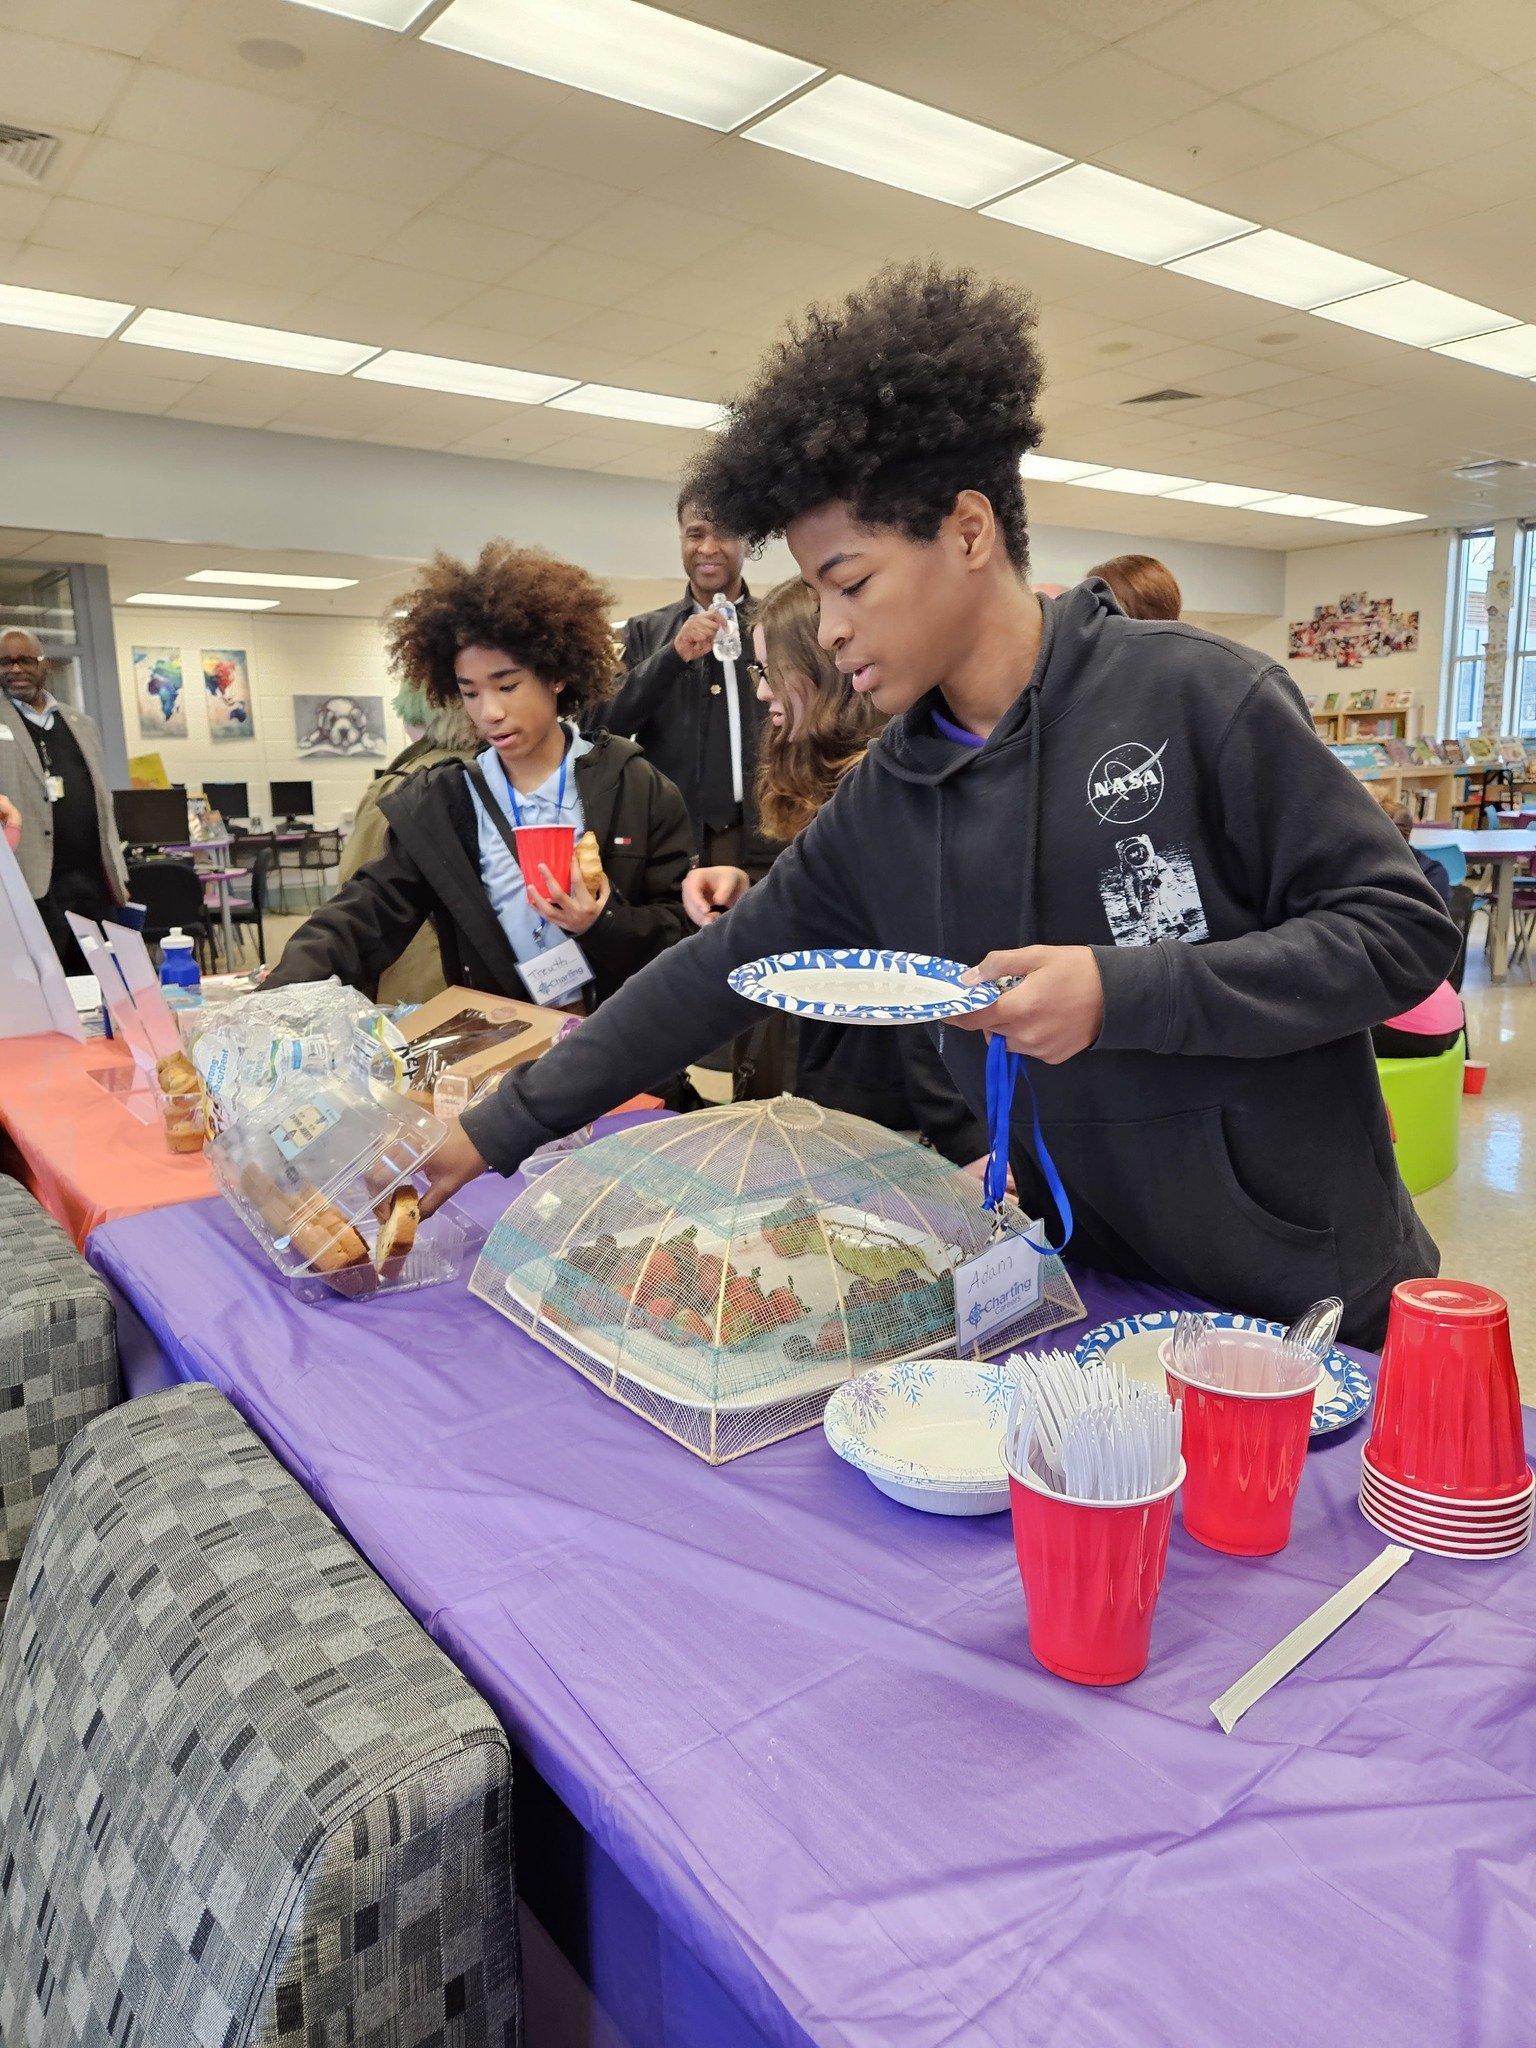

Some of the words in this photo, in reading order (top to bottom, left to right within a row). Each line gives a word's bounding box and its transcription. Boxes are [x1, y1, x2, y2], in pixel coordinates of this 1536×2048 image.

[1093, 769, 1160, 799] NASA
[549, 966, 584, 988] Charting
[967, 1256, 1014, 1294] Adam
[984, 1278, 1032, 1313] Charting
